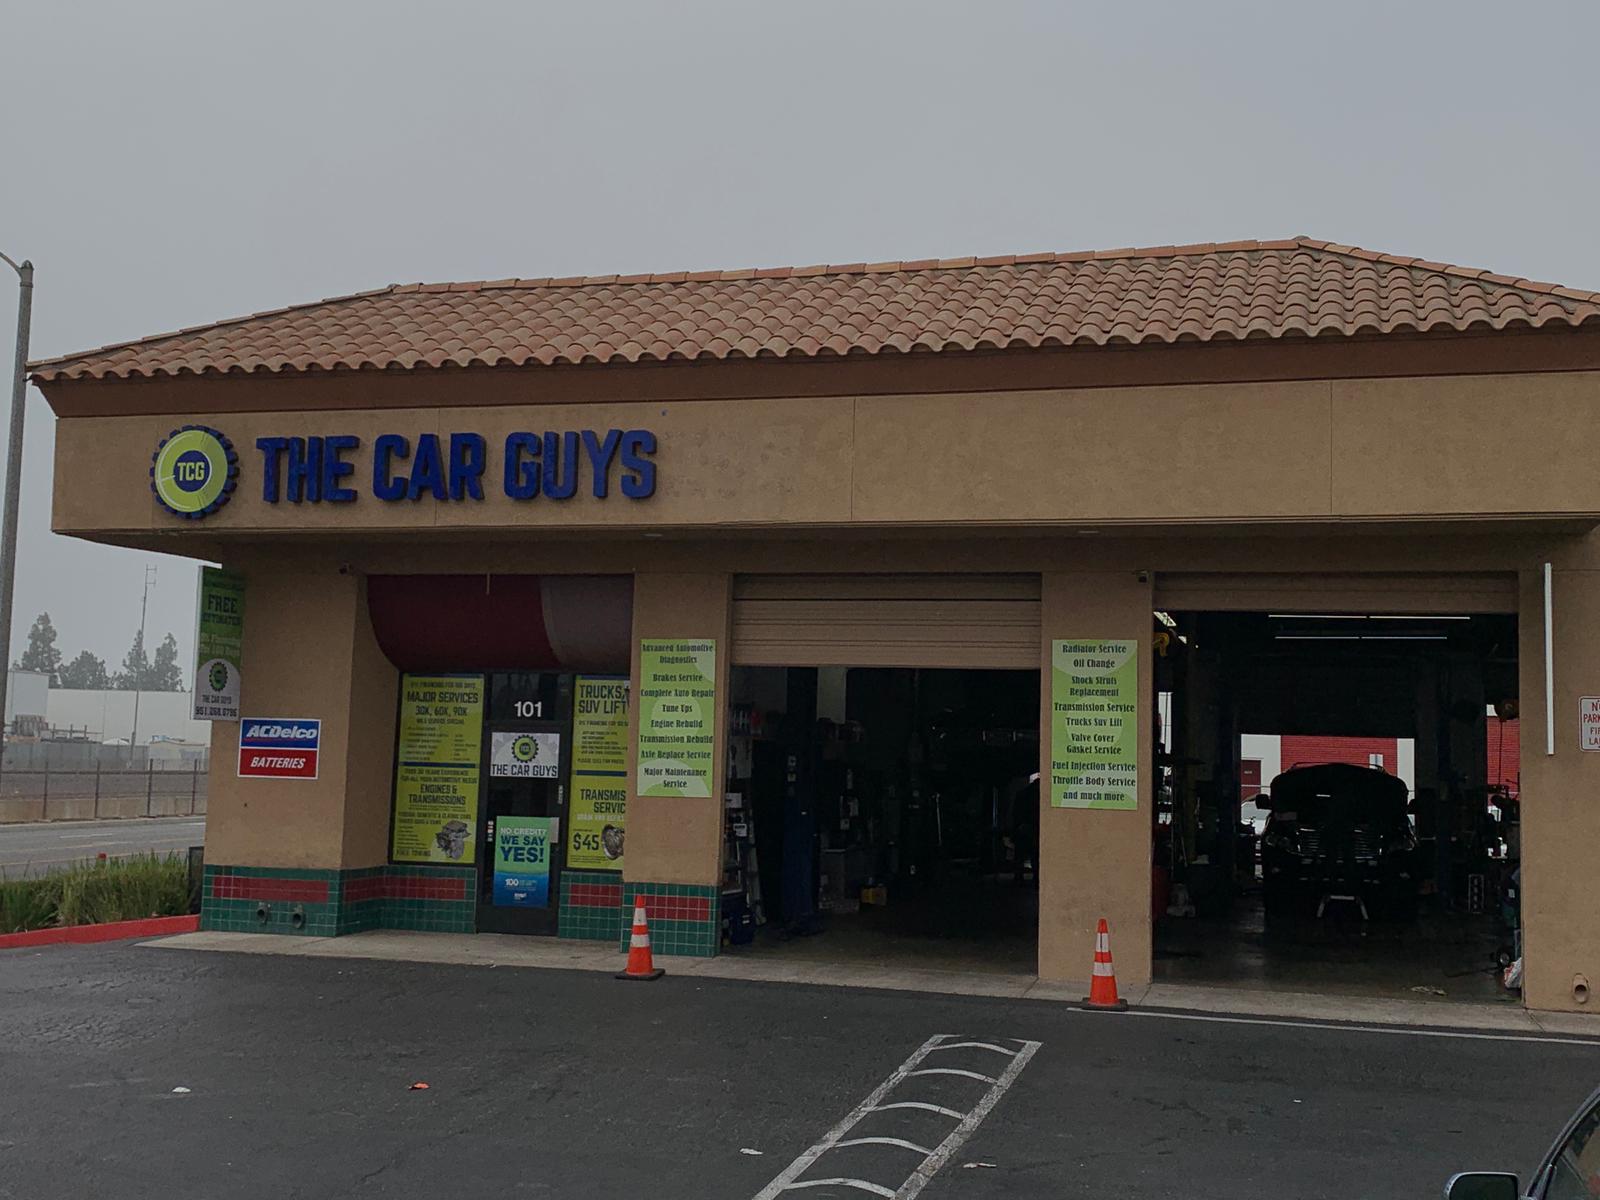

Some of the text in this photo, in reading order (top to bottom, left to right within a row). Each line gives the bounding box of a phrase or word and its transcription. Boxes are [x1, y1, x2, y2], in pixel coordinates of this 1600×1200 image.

[177, 461, 205, 481] TCG
[256, 429, 657, 503] THE CAR GUYS
[208, 594, 238, 613] FREE
[1062, 644, 1127, 653] Radiator Service
[1073, 658, 1116, 669] Oil Change
[652, 673, 703, 682] Brakes Service
[1071, 675, 1117, 685] Shock Struts
[640, 689, 715, 698] Complete Auto Repair
[1069, 687, 1119, 697] Replacement
[407, 691, 479, 704] MAJOR SERVICES
[514, 700, 543, 718] 101
[578, 699, 601, 714] SUV
[662, 704, 679, 713] Tune
[1054, 702, 1135, 712] Transmission Service
[650, 719, 703, 729] Engine Rebuild
[1065, 717, 1092, 726] Trucks
[1109, 718, 1123, 727] Lift
[246, 724, 318, 739] ACDelco
[640, 735, 713, 744] Transmission Rebuild
[1071, 733, 1115, 743] Valve Cover
[657, 750, 685, 760] Replace
[686, 750, 712, 759] Service
[1066, 745, 1122, 755] Gasket Service
[250, 756, 306, 770] BATTERIES
[1052, 760, 1136, 772] Fuel Injection Service
[492, 763, 558, 777] THE CAR GUYS
[643, 767, 707, 777] Major Maintenance
[663, 779, 688, 788] Service
[1052, 775, 1136, 787] Throttle Body Service
[408, 794, 467, 805] TRANSMISSIONS
[1063, 791, 1125, 801] and much more
[500, 827, 513, 835] NO
[500, 835, 545, 846] WE SAY
[573, 832, 600, 851] $45
[500, 846, 544, 863] YES!
